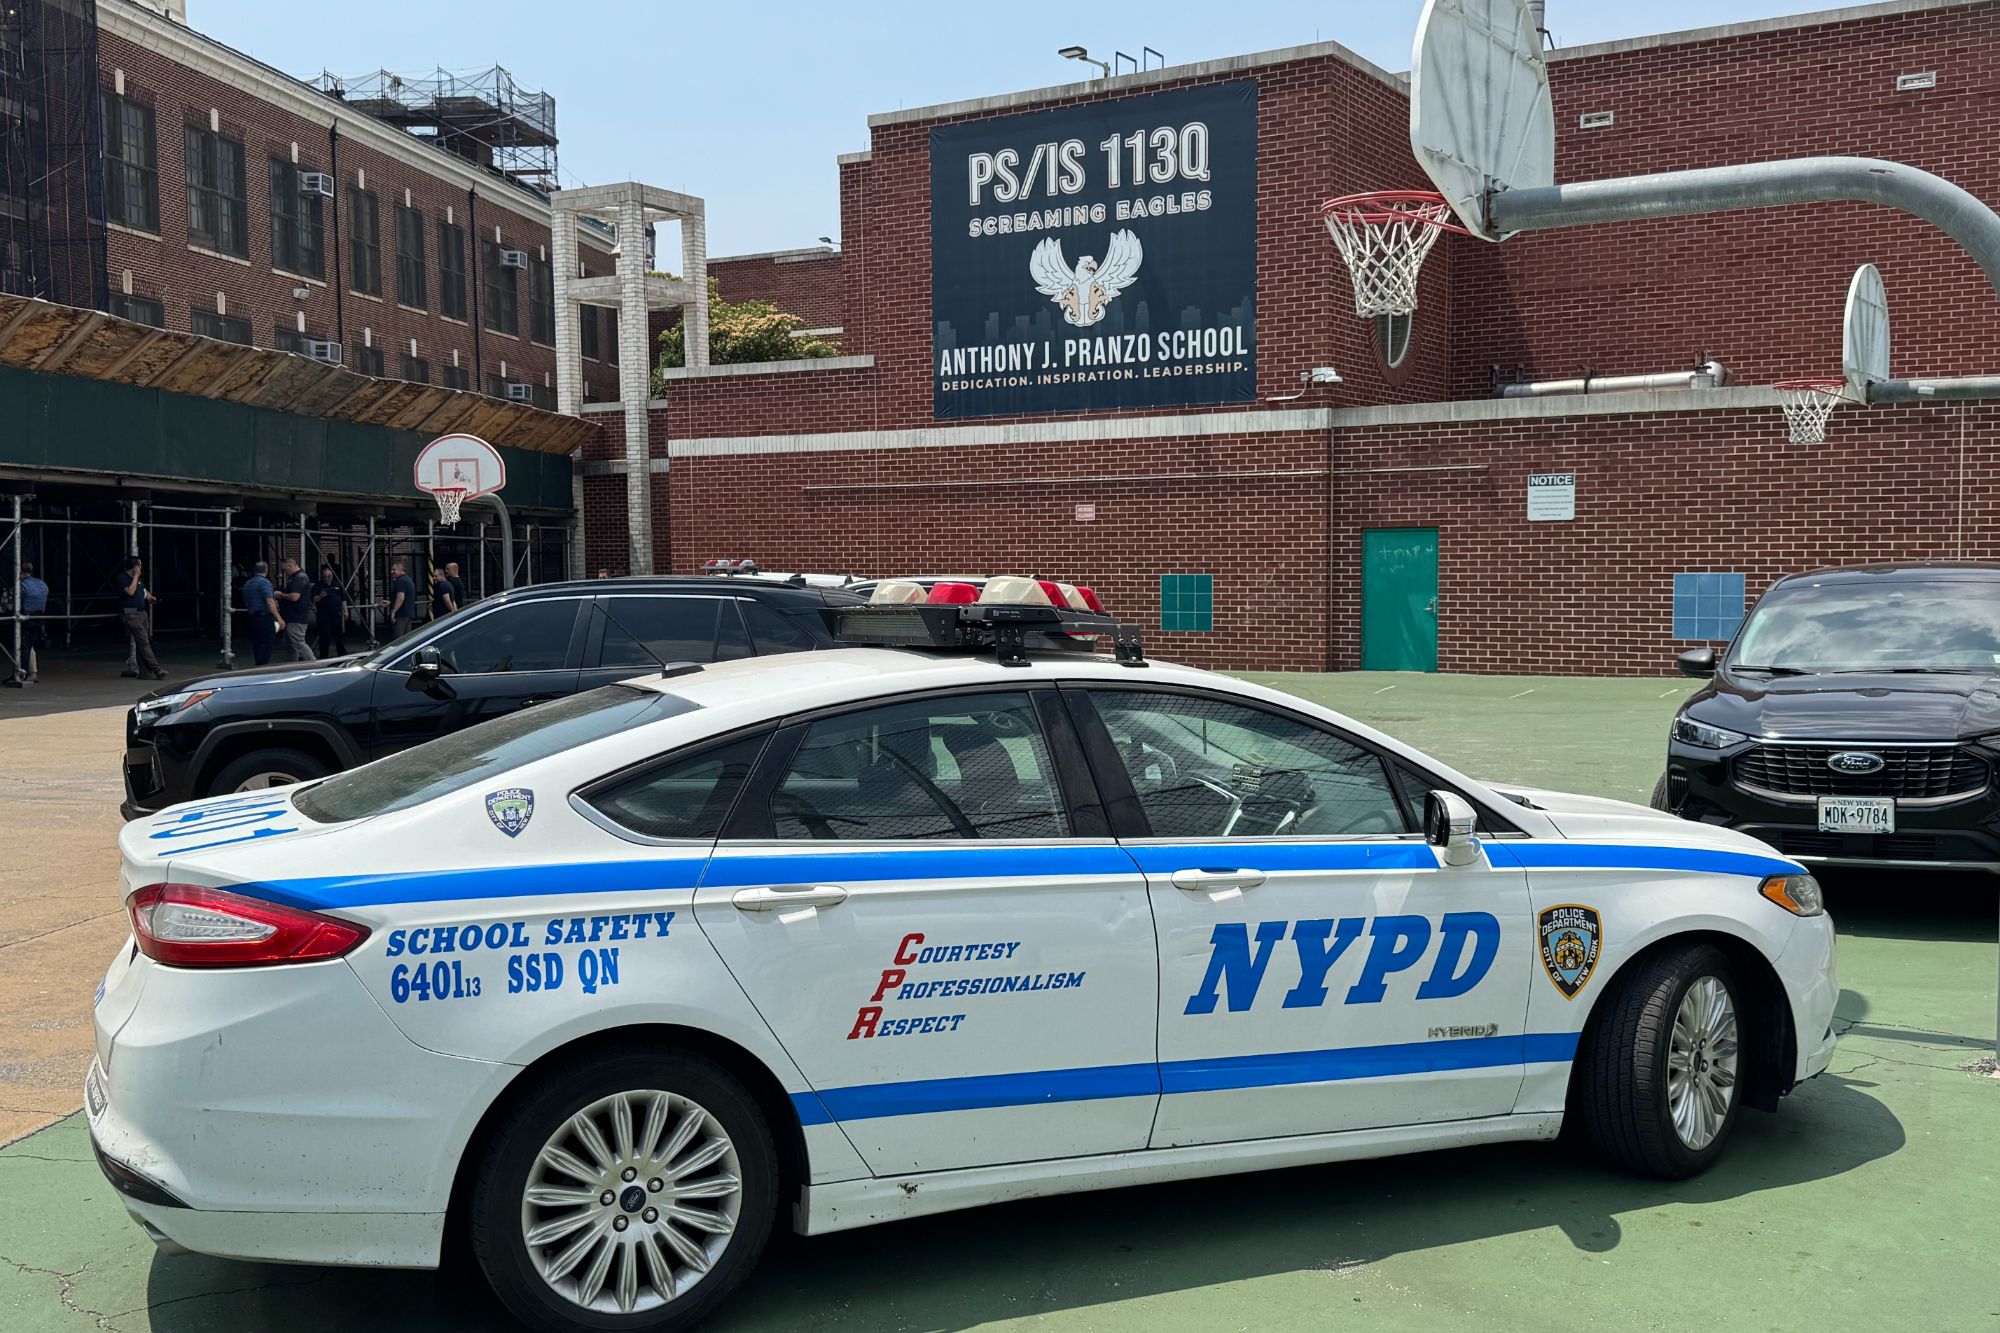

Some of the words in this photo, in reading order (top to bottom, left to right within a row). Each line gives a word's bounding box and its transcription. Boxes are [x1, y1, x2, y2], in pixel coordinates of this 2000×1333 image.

[969, 139, 1086, 206] PS/IS
[1100, 121, 1211, 189] 113Q
[968, 203, 1107, 238] SCREAMING
[1115, 190, 1213, 221] EAGLES
[939, 341, 1036, 377] ANTHONY
[1041, 340, 1058, 370] J.
[1064, 332, 1151, 368] PRANZO
[1157, 325, 1249, 362] SCHOOL
[941, 376, 1034, 392] DEDICATION.
[1037, 368, 1140, 385] INSPIRATION.
[1143, 361, 1249, 378] LEADERSHIP.
[1530, 475, 1573, 486] NOTICE
[1840, 754, 1872, 769] Ford
[1837, 799, 1854, 807] NEW
[1855, 799, 1875, 807] YORK
[1541, 918, 1598, 937] DEPARTMENT
[1552, 908, 1586, 921] POLICE
[386, 921, 530, 957] SCHOOL
[544, 911, 676, 946] SAFETY
[507, 952, 565, 994] SSD
[577, 947, 620, 995] QN
[1183, 911, 1501, 1016] NYPD
[1543, 946, 1555, 969] CITY
[1552, 971, 1563, 983] OF
[1574, 966, 1590, 987] NEW
[1586, 939, 1599, 964] YORK
[1427, 1024, 1486, 1038] HYBRID
